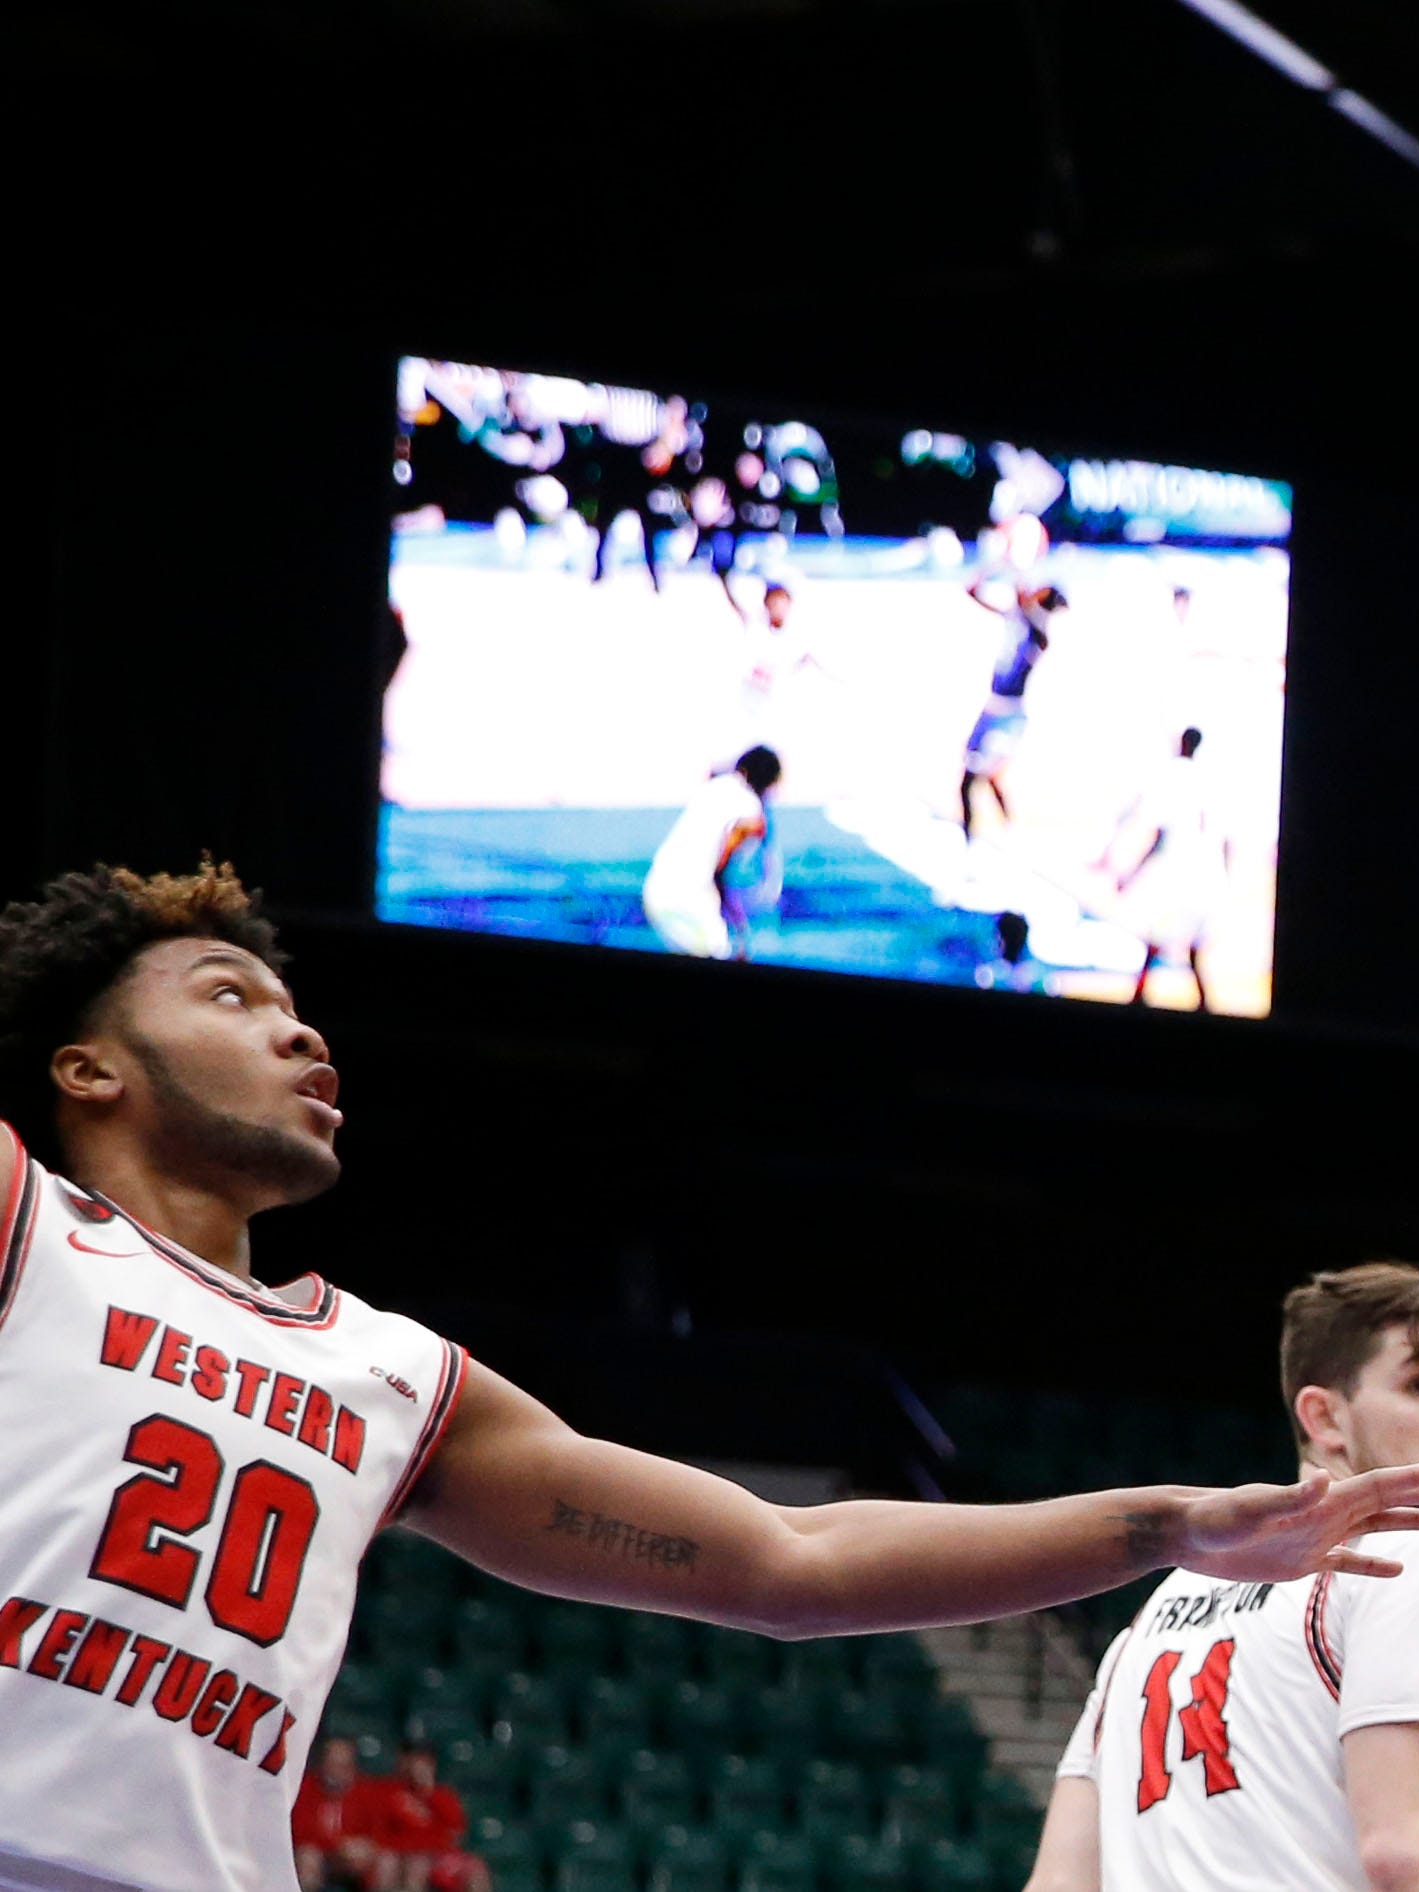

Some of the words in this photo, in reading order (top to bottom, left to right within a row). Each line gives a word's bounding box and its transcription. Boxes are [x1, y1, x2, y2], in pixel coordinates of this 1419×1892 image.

[99, 1304, 367, 1475] WESTERN
[88, 1411, 321, 1649] 20
[1137, 1638, 1241, 1814] 14
